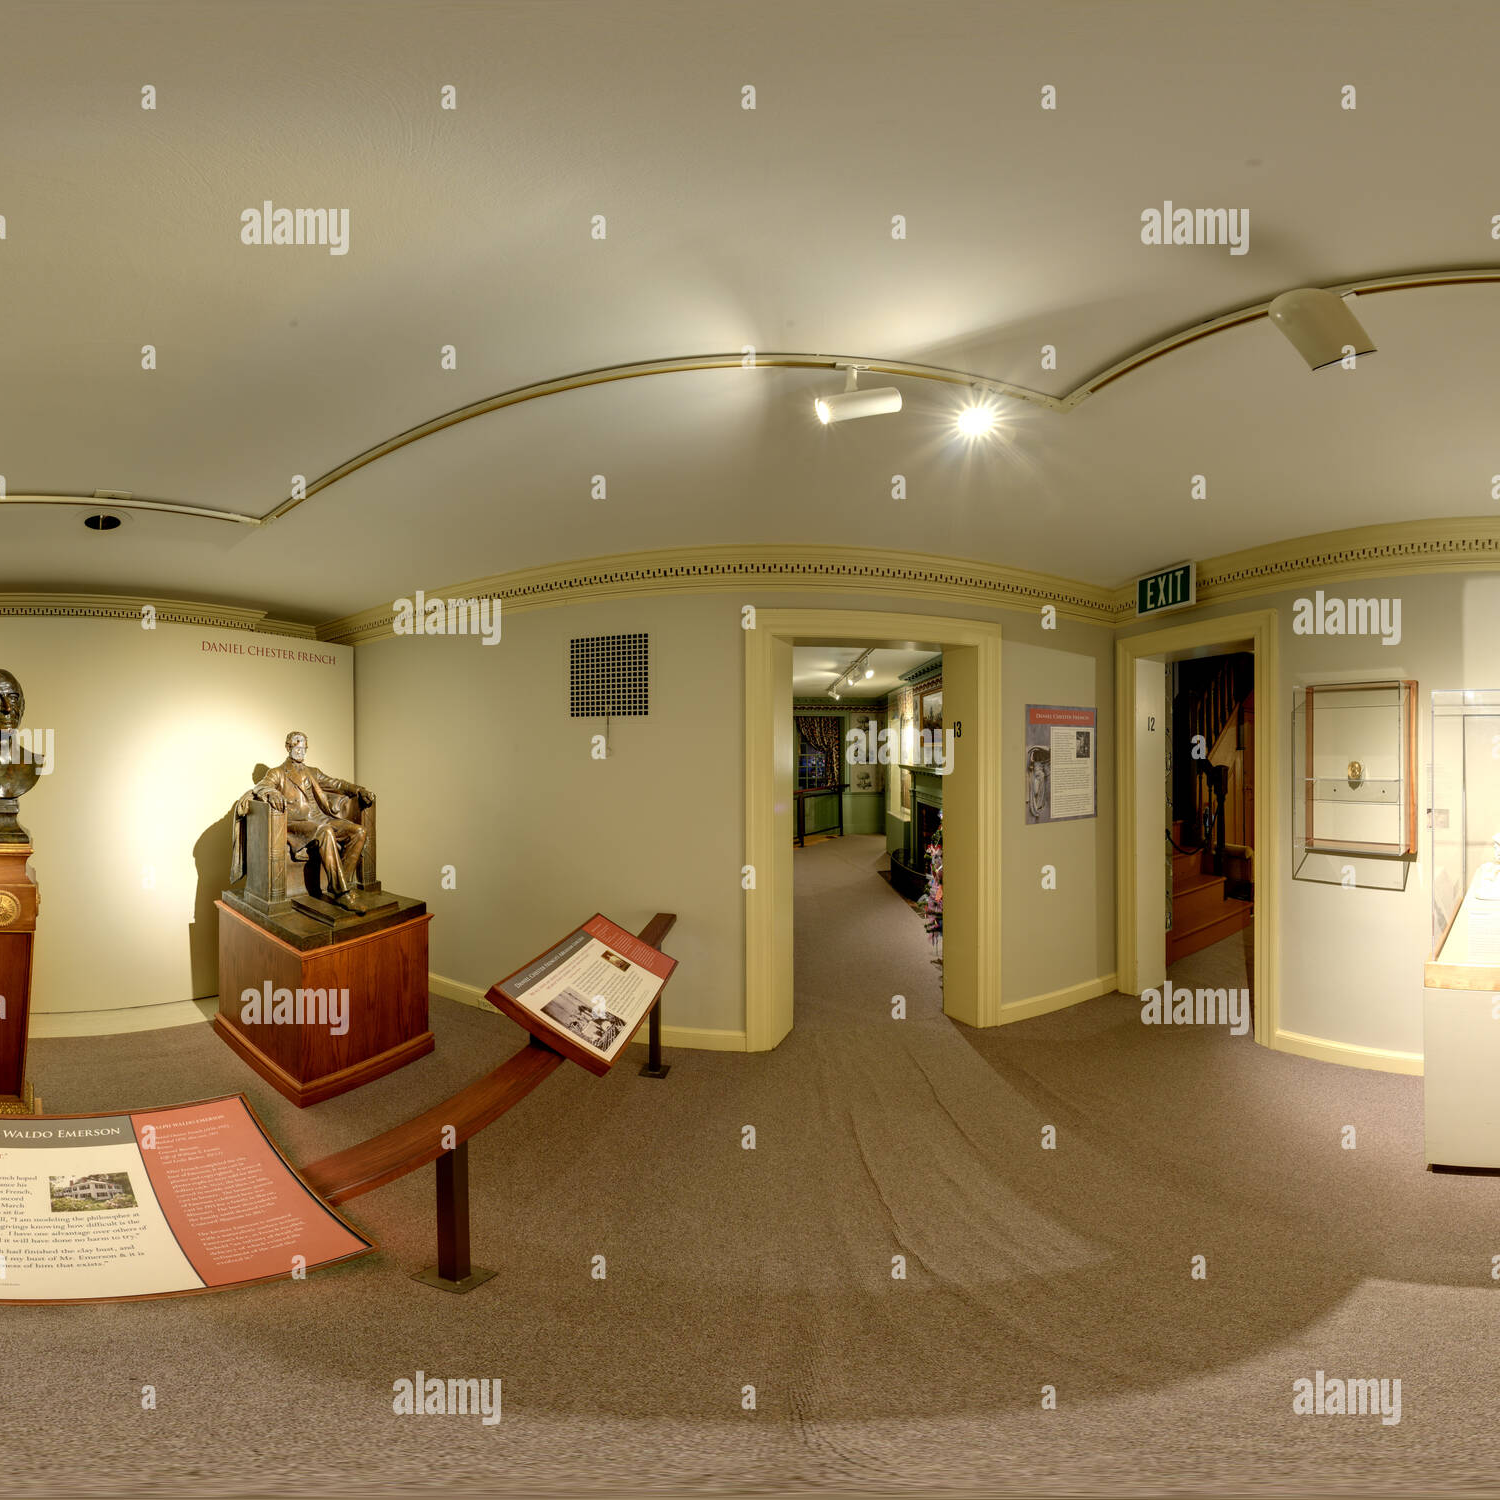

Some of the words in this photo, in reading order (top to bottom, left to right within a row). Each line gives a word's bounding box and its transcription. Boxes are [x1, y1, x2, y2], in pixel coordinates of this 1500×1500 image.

[1147, 570, 1184, 610] EXIT
[202, 640, 244, 654] DANIEL
[248, 646, 295, 660] CHESTER
[298, 652, 336, 665] FRENCH
[953, 721, 962, 738] 13
[1147, 716, 1156, 732] 12
[2, 1129, 53, 1139] WALDO
[58, 1127, 121, 1138] EMERSON
